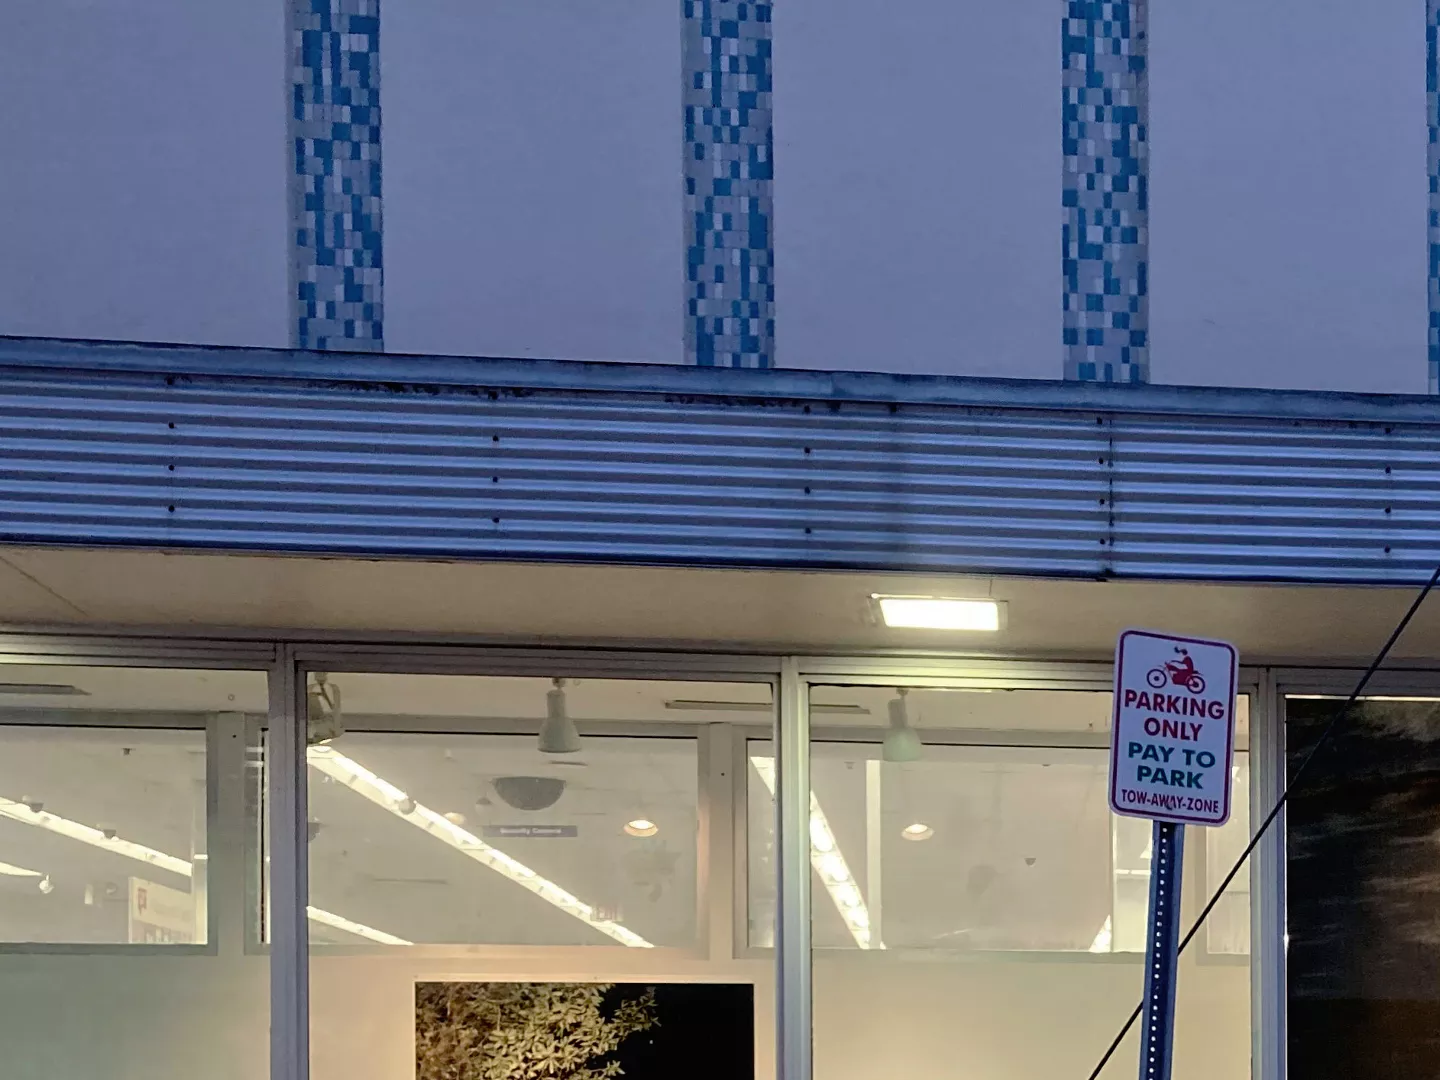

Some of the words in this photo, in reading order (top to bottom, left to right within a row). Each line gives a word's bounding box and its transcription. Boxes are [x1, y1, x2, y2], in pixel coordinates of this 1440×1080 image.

[1124, 689, 1225, 720] PARKING
[1144, 717, 1203, 742] ONLY
[1128, 741, 1175, 763] PAY
[1182, 749, 1216, 768] TO
[1136, 765, 1204, 789] PARK
[1121, 789, 1219, 813] TOW-AWAY-ZONE
